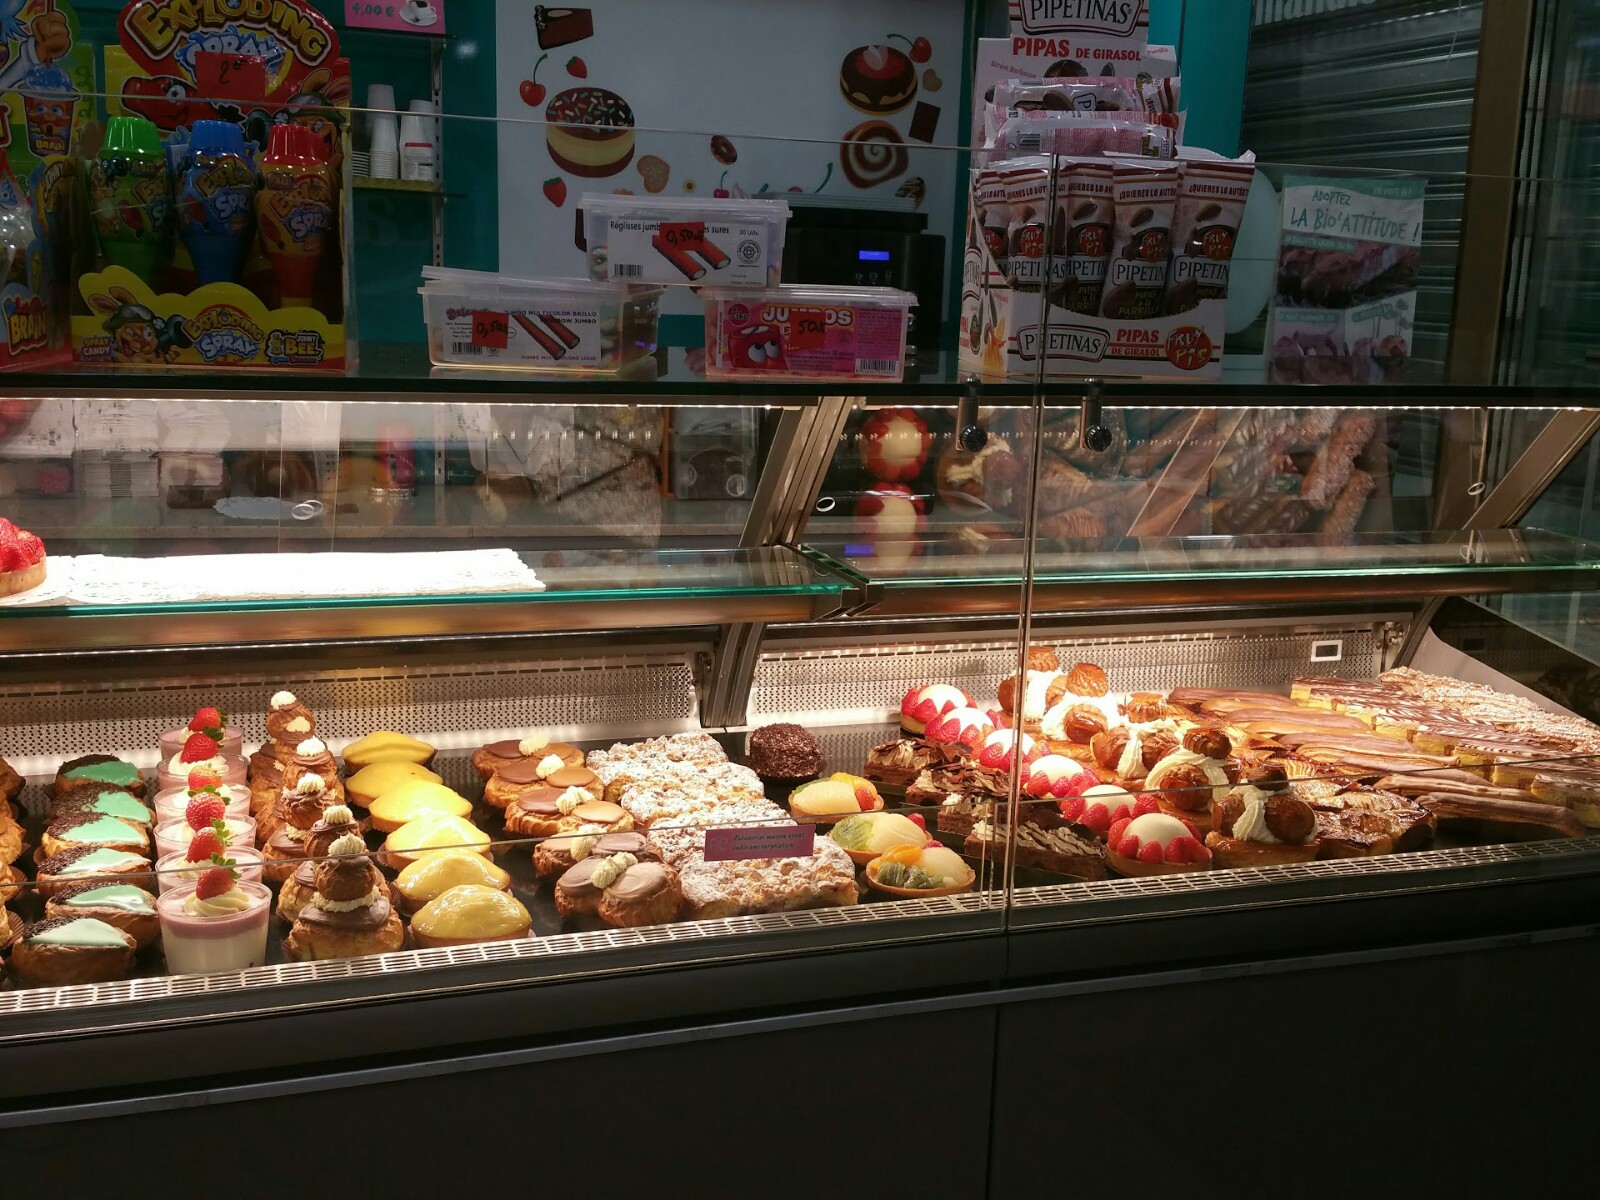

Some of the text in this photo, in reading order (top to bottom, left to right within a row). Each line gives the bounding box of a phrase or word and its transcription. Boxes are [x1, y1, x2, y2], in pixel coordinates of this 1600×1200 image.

[1031, 0, 1131, 24] PIPETINAS
[1012, 37, 1142, 61] PIPAS DE GIRASOL
[1150, 190, 1159, 199] LO
[1220, 185, 1228, 194] LO
[1312, 189, 1351, 206] ADOPTEZ
[1291, 207, 1308, 228] LA
[610, 221, 641, 232] Réglisses
[712, 226, 730, 234] sures
[762, 306, 854, 326] JUOS
[186, 311, 265, 342] EXPLODING
[1024, 332, 1101, 355] PIETINAS
[1116, 329, 1160, 343] PIPAS
[83, 347, 110, 356] CANDY
[285, 338, 316, 355] BEE
[1111, 347, 1160, 357] DE GIRASOL
